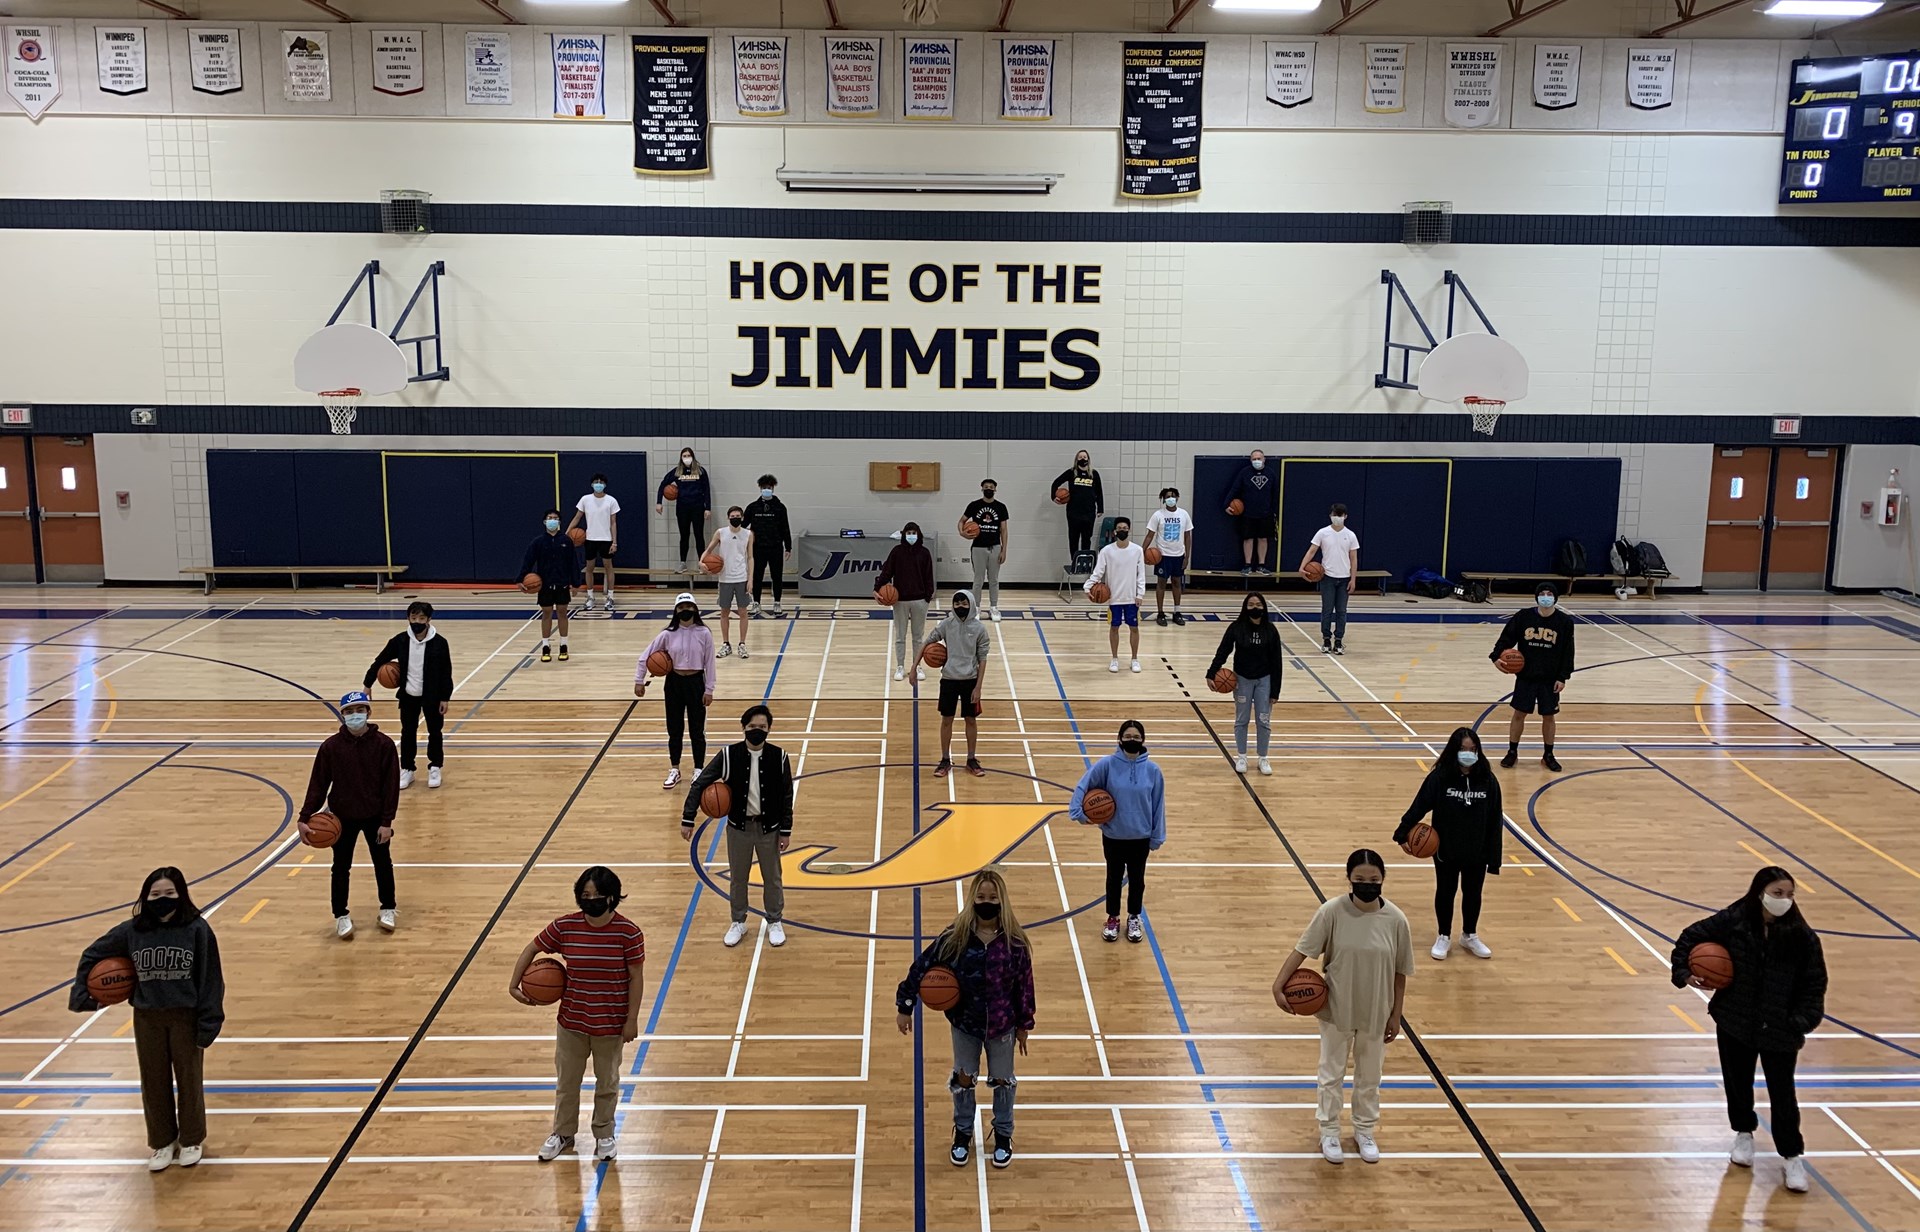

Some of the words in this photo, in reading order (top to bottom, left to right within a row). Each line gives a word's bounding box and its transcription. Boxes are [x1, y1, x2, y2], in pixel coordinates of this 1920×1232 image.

[105, 32, 135, 42] WINNIPEG
[198, 34, 229, 43] WINNIPEG
[557, 39, 600, 50] MHSAA
[634, 45, 670, 53] PROVINCIAL
[738, 41, 782, 51] MHSAA
[831, 41, 875, 52] MHSAA
[909, 43, 951, 54] MHSAA
[1007, 44, 1049, 56] MHSAA
[1125, 49, 1163, 57] CONFERENCE
[1168, 49, 1204, 57] CHAMPIONS
[557, 52, 600, 62] PROVINCIAL
[831, 53, 875, 61] PROVINCIAL
[909, 56, 951, 66] PROVINCIAL
[1451, 51, 1496, 61] WWHSHL
[760, 63, 779, 71] BOYS
[1007, 57, 1049, 67] PROVINCIAL
[1125, 58, 1162, 66] CLOVERLEAF
[1165, 58, 1203, 66] CONFERENCE
[584, 65, 600, 73] BOYS
[739, 72, 781, 81] BASKETBALL
[832, 74, 874, 82] BASKETBALL
[742, 83, 780, 91] CHAMPIONS
[838, 95, 869, 103] 2012-2013
[1168, 96, 1184, 104] GIRLS
[647, 105, 684, 113] WATERPOLO
[1822, 107, 1848, 140] 0
[1895, 112, 1915, 135] 9
[641, 133, 667, 141] WOMENS
[669, 133, 702, 141] HANDBALL
[1786, 151, 1800, 160] TM
[1802, 150, 1830, 159] FOULS
[1868, 147, 1903, 157] PLAYER
[1124, 158, 1160, 167] CROSSTOWN
[1162, 156, 1198, 166] CONFERENCE
[1179, 172, 1196, 180] VARSITY
[1804, 162, 1823, 187] 0
[1789, 190, 1818, 199] POINTS
[1884, 188, 1912, 197] MATCH
[729, 260, 891, 303] HOME
[908, 262, 981, 304] OF
[995, 262, 1103, 304] THE
[729, 324, 1102, 391] JIMMIES
[8, 409, 23, 422] EXIT
[1779, 420, 1796, 433] EXIT
[132, 946, 194, 971] ROOTS
